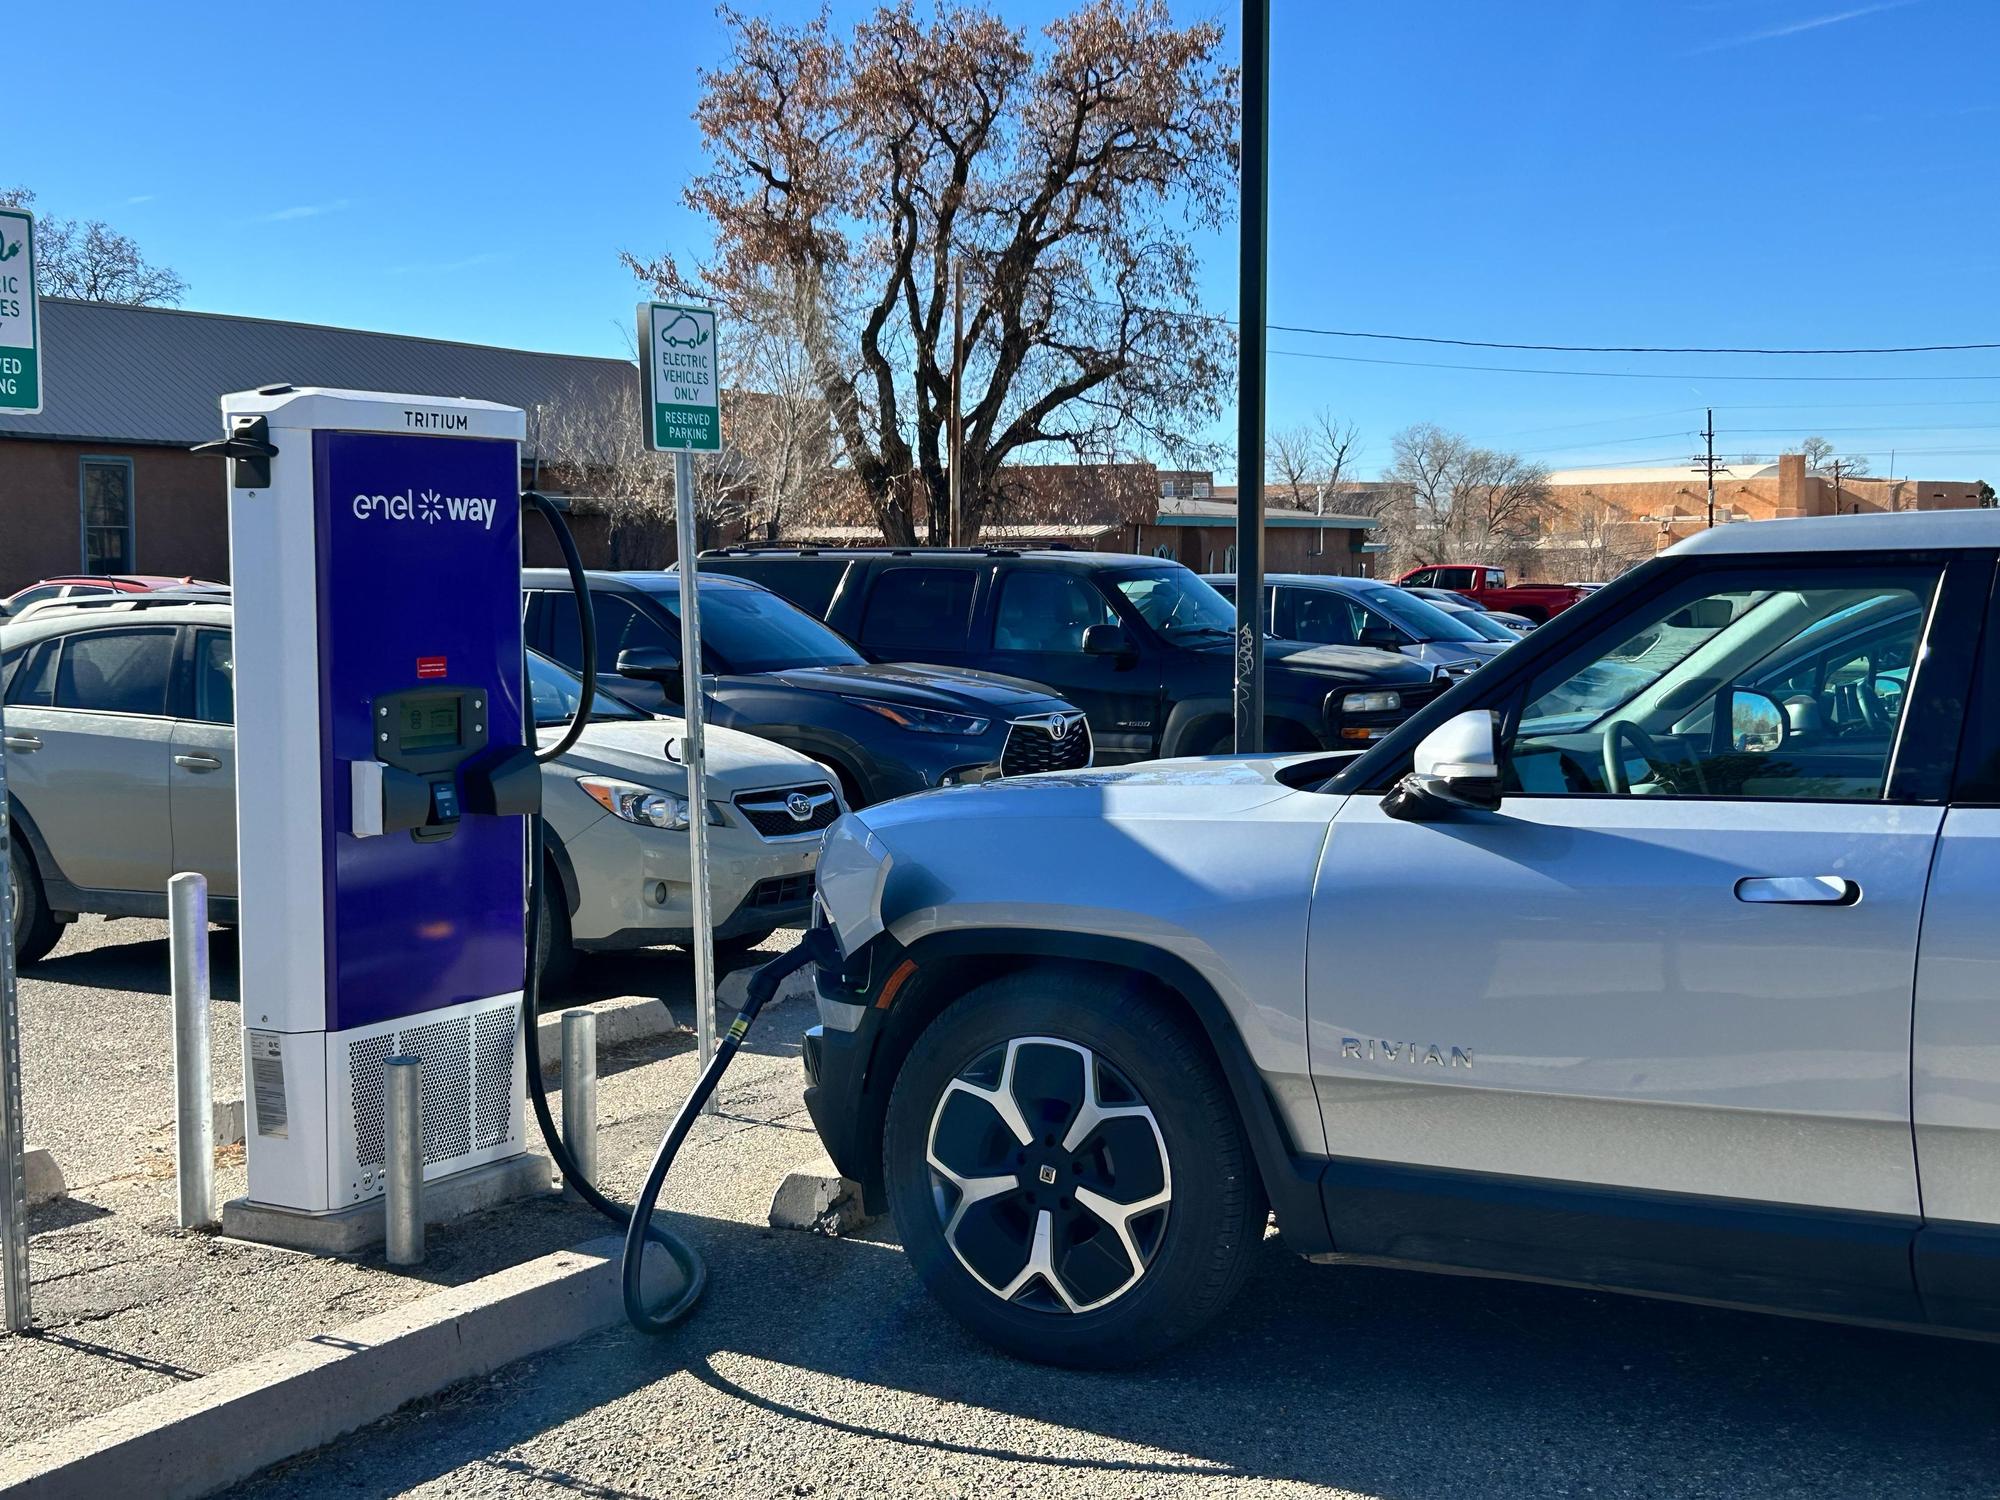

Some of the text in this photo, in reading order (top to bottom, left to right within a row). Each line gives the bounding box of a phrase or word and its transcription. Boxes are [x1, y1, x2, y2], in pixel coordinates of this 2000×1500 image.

[663, 352, 708, 369] ELECTRIC
[663, 369, 709, 385] VEHICLES
[674, 386, 699, 401] ONLY
[404, 411, 468, 430] TRITIUM
[665, 411, 710, 426] RESERVED
[669, 426, 708, 441] PARKING
[352, 488, 497, 530] enel way
[1341, 1037, 1473, 1069] RIVIAN
